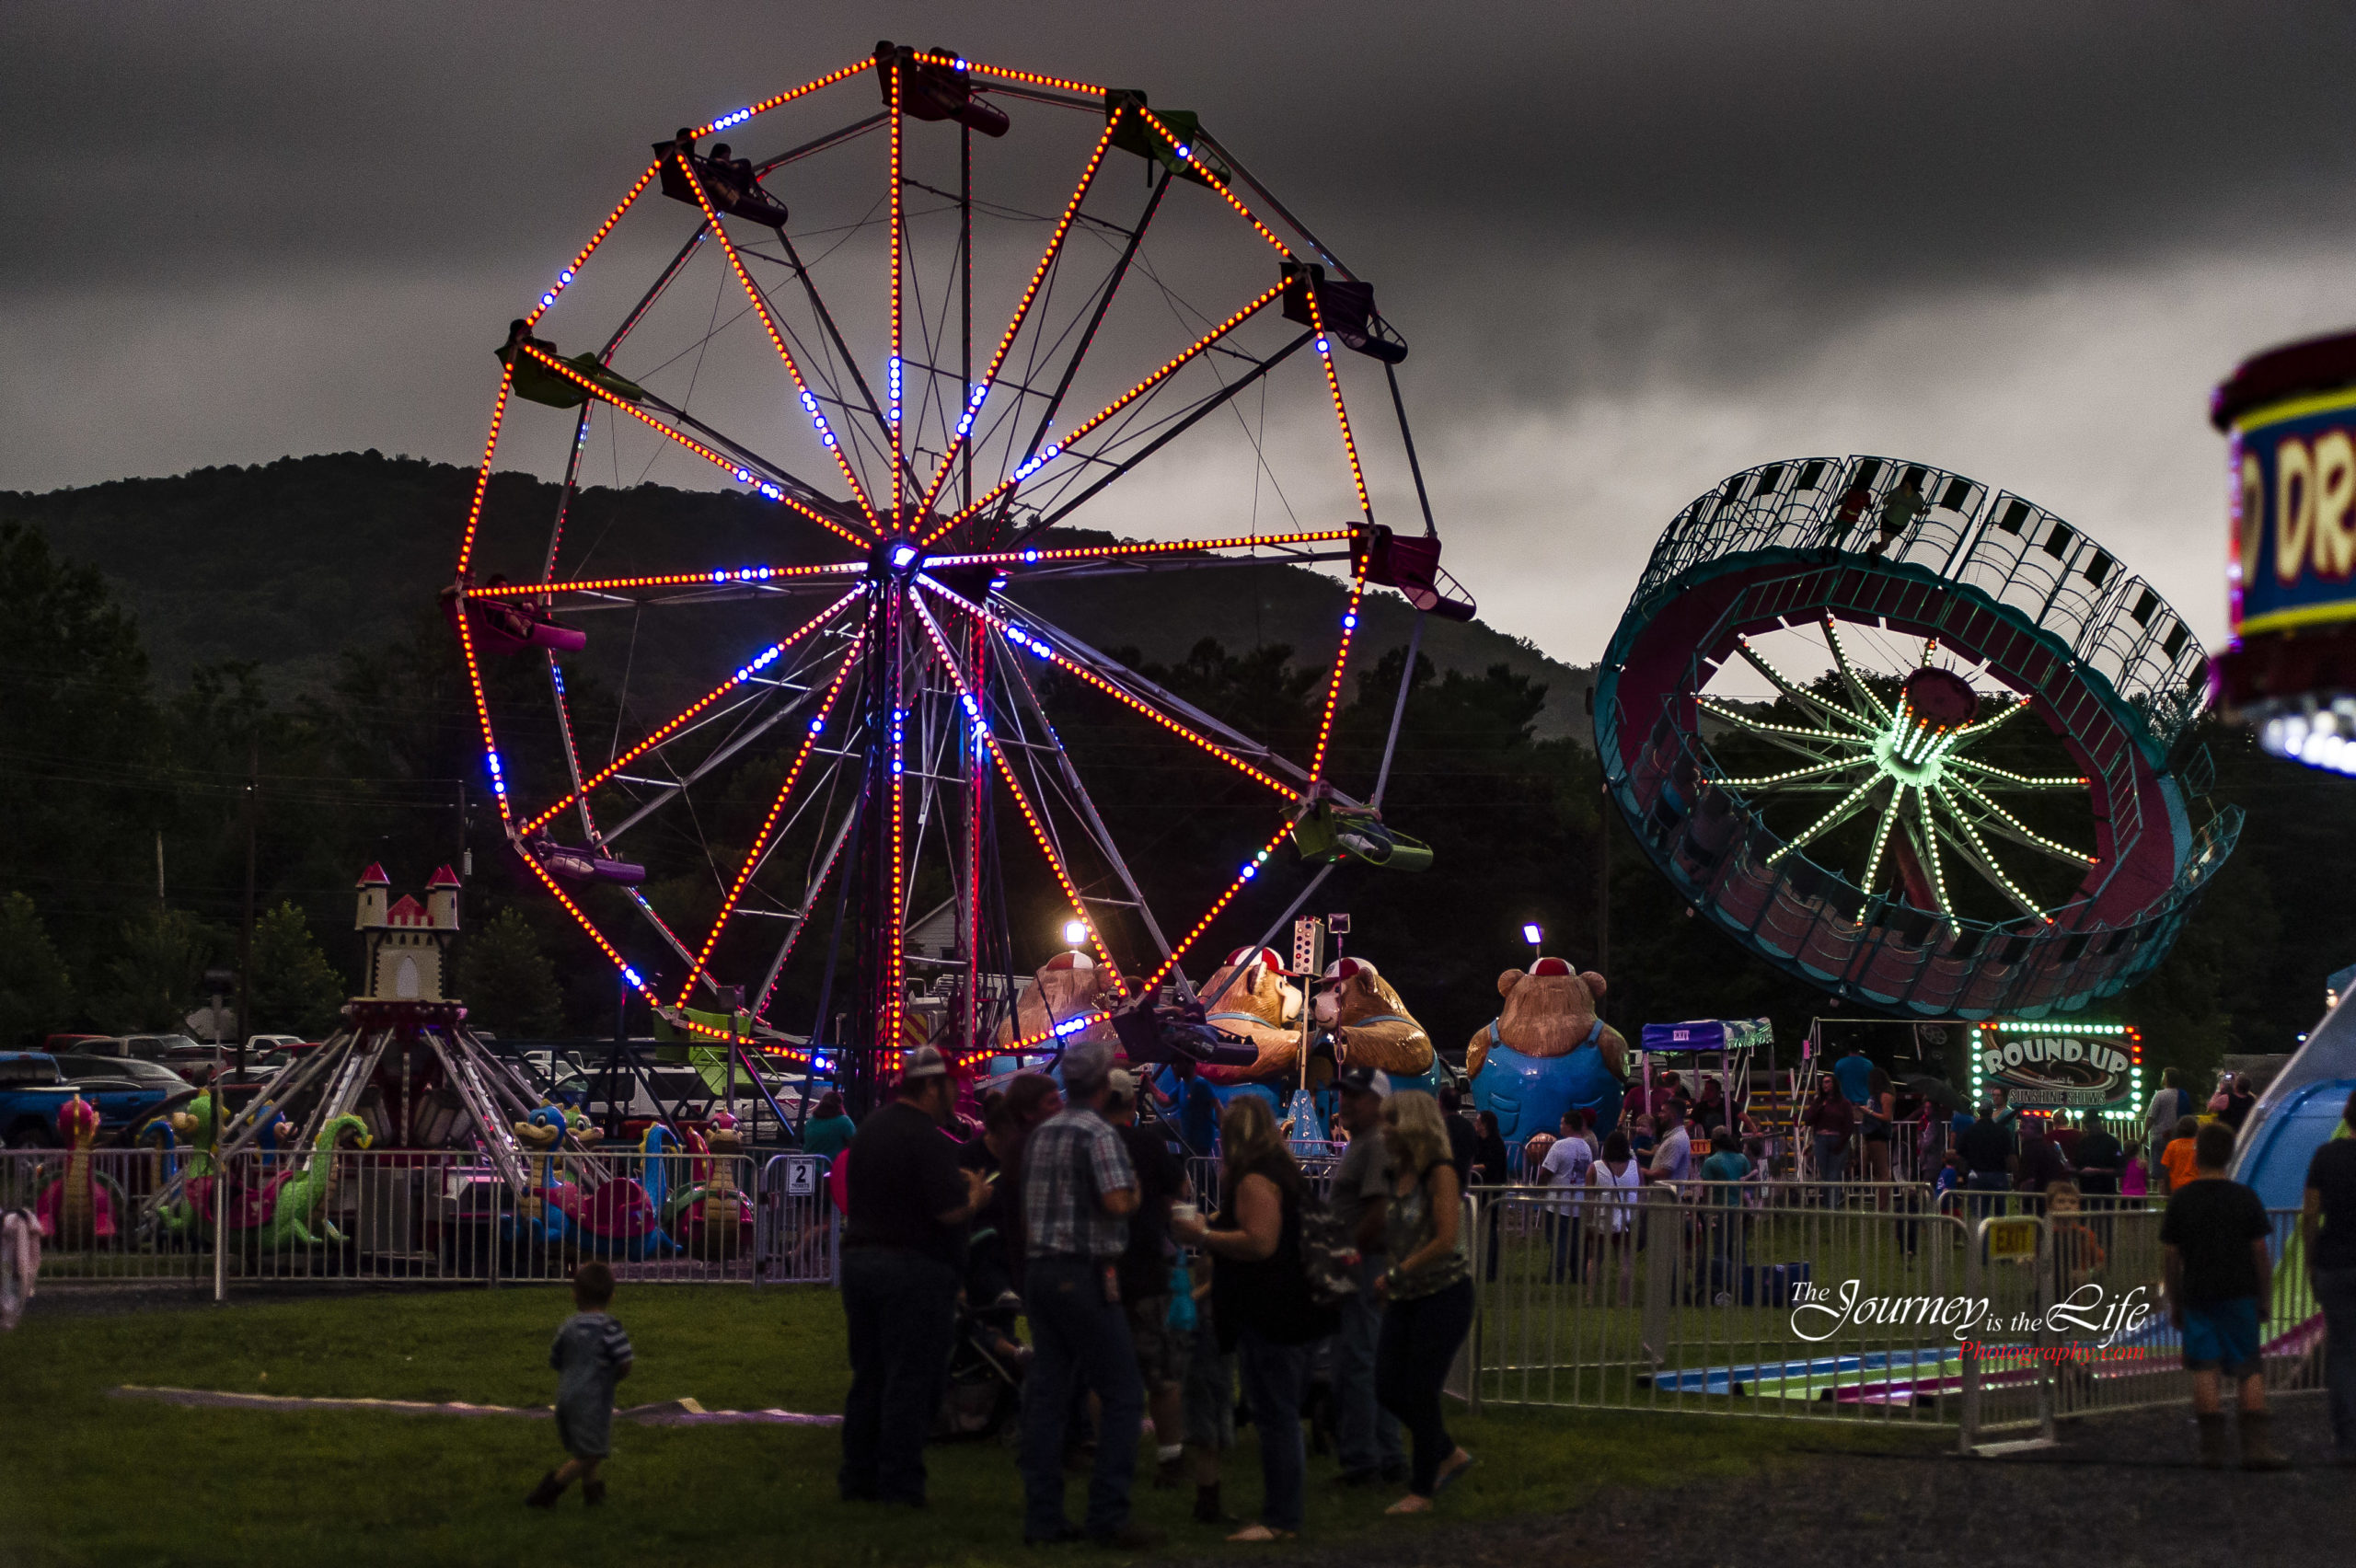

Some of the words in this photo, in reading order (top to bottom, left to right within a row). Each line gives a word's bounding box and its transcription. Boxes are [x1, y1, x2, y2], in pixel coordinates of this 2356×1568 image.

[2009, 1089, 2064, 1104] SUNSHINE
[2066, 1090, 2107, 1105] SHOWS
[1690, 1141, 1707, 1152] XIT
[795, 1165, 806, 1182] 2
[1997, 1223, 2028, 1253] EXIT
